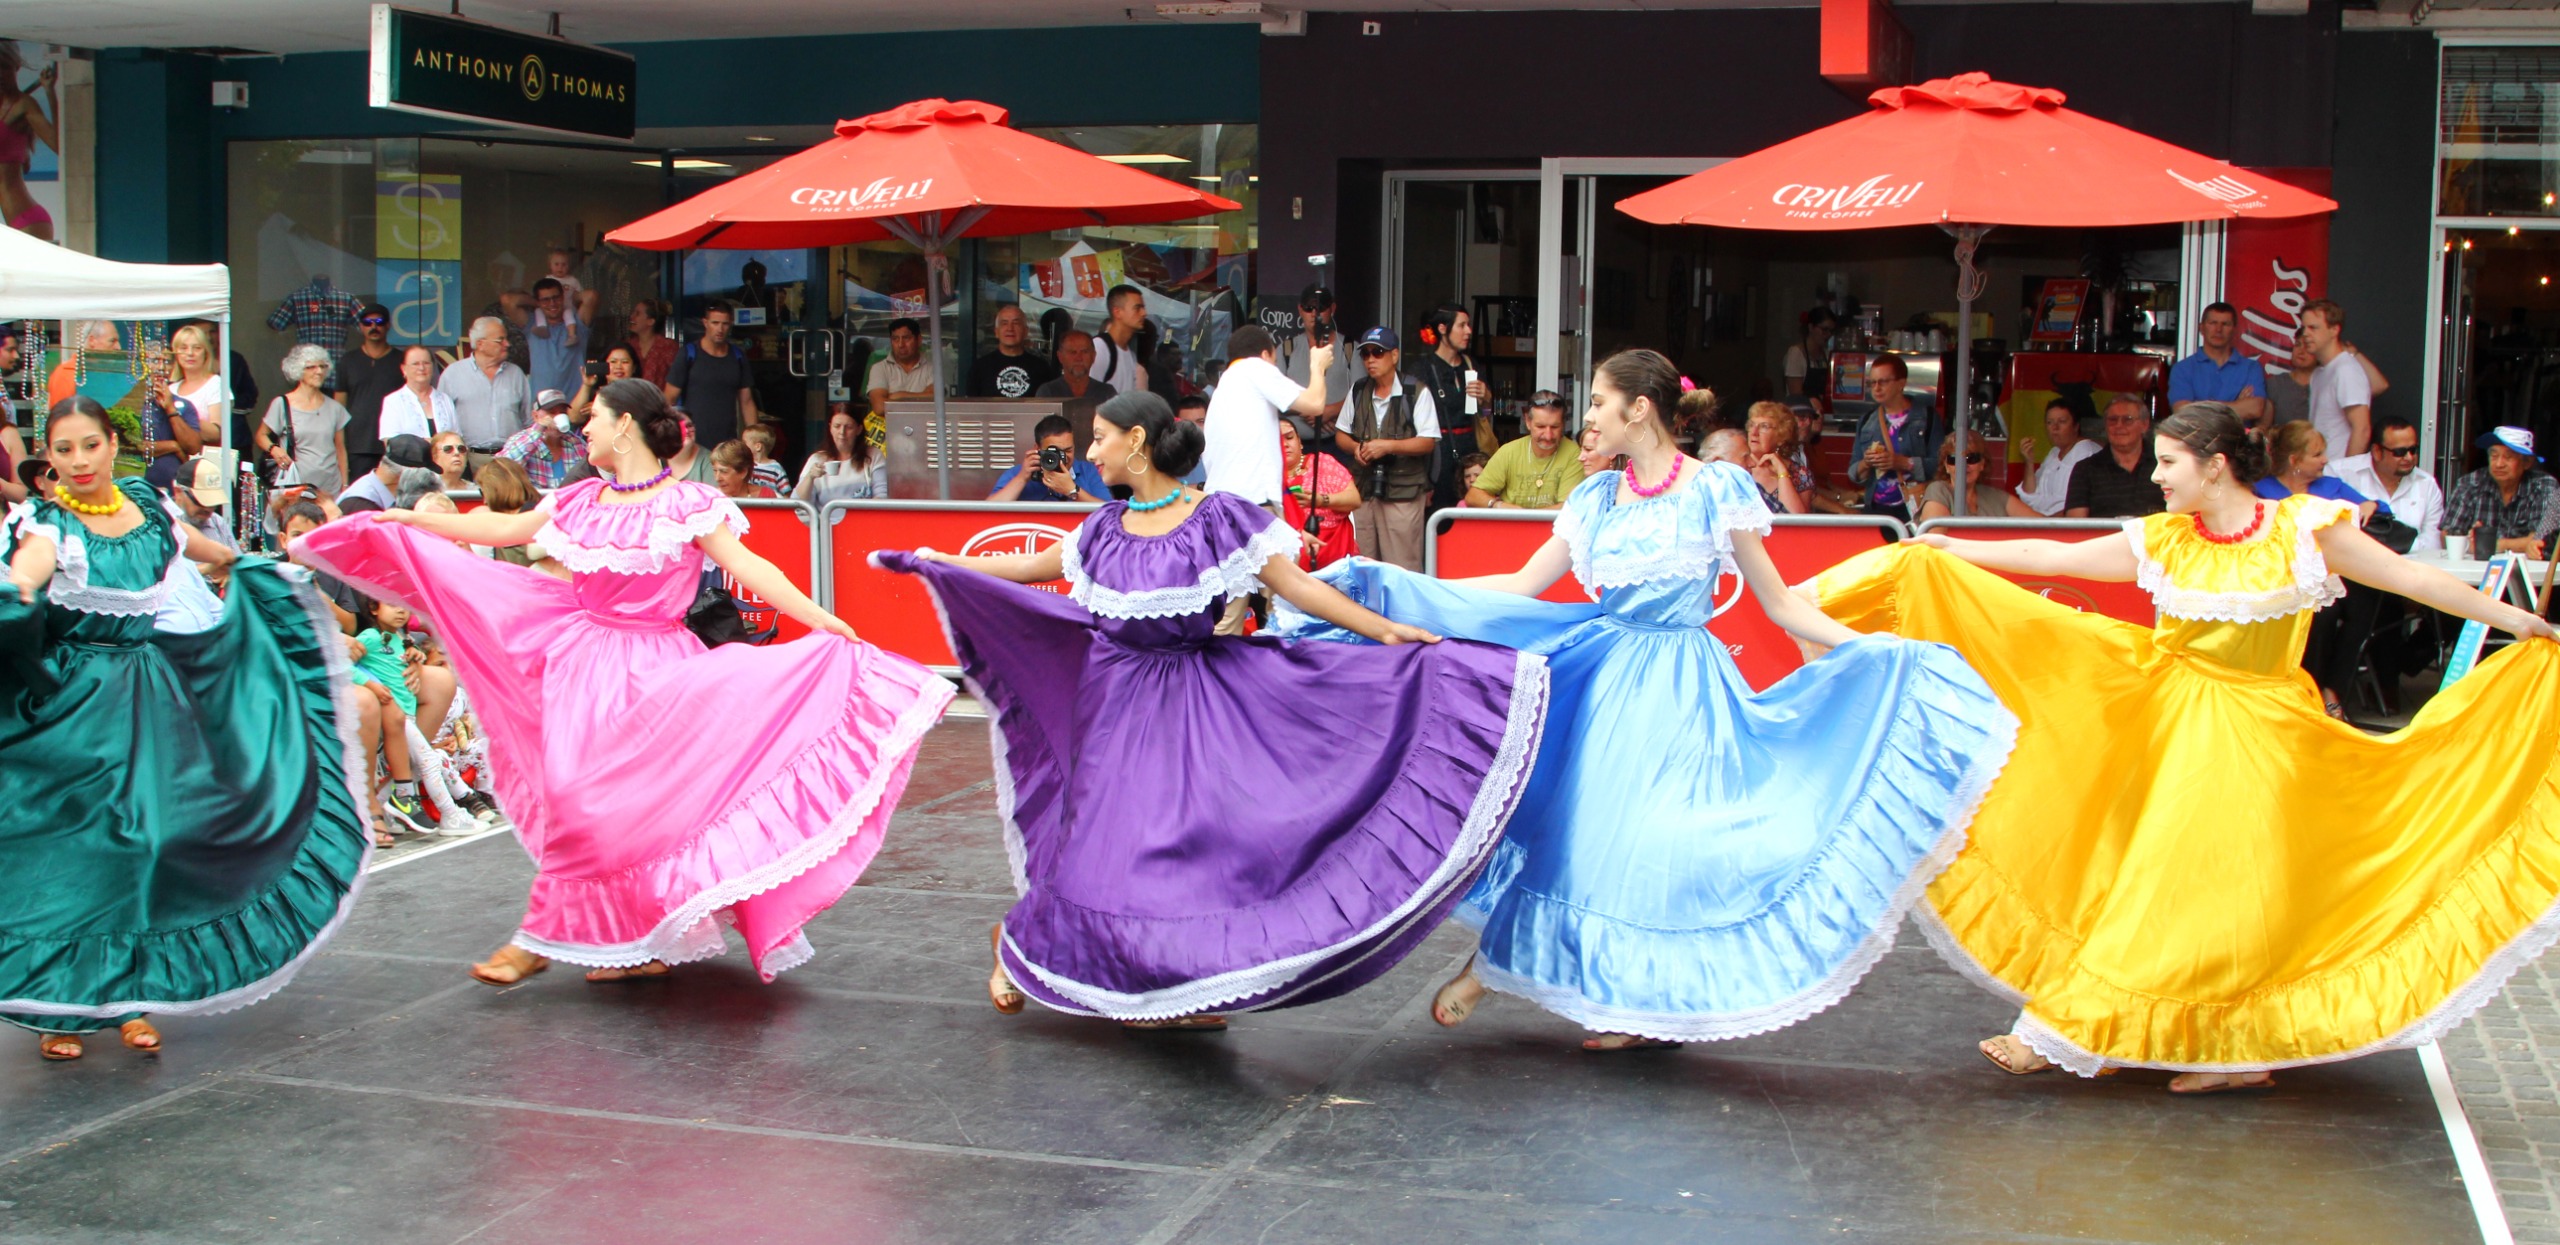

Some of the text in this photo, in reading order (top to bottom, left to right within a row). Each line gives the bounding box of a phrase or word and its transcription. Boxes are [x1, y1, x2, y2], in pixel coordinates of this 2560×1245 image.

[414, 48, 513, 82] ANTHONY
[551, 73, 625, 102] THOMAS
[790, 176, 933, 206] CRIVELLI
[1772, 174, 1924, 211] CRIVELLI
[846, 202, 896, 212] COFFEE
[1785, 209, 1875, 219] FINE COFFEE
[894, 295, 923, 319] $39
[1260, 307, 1293, 329] Come
[742, 612, 762, 622] FEE
